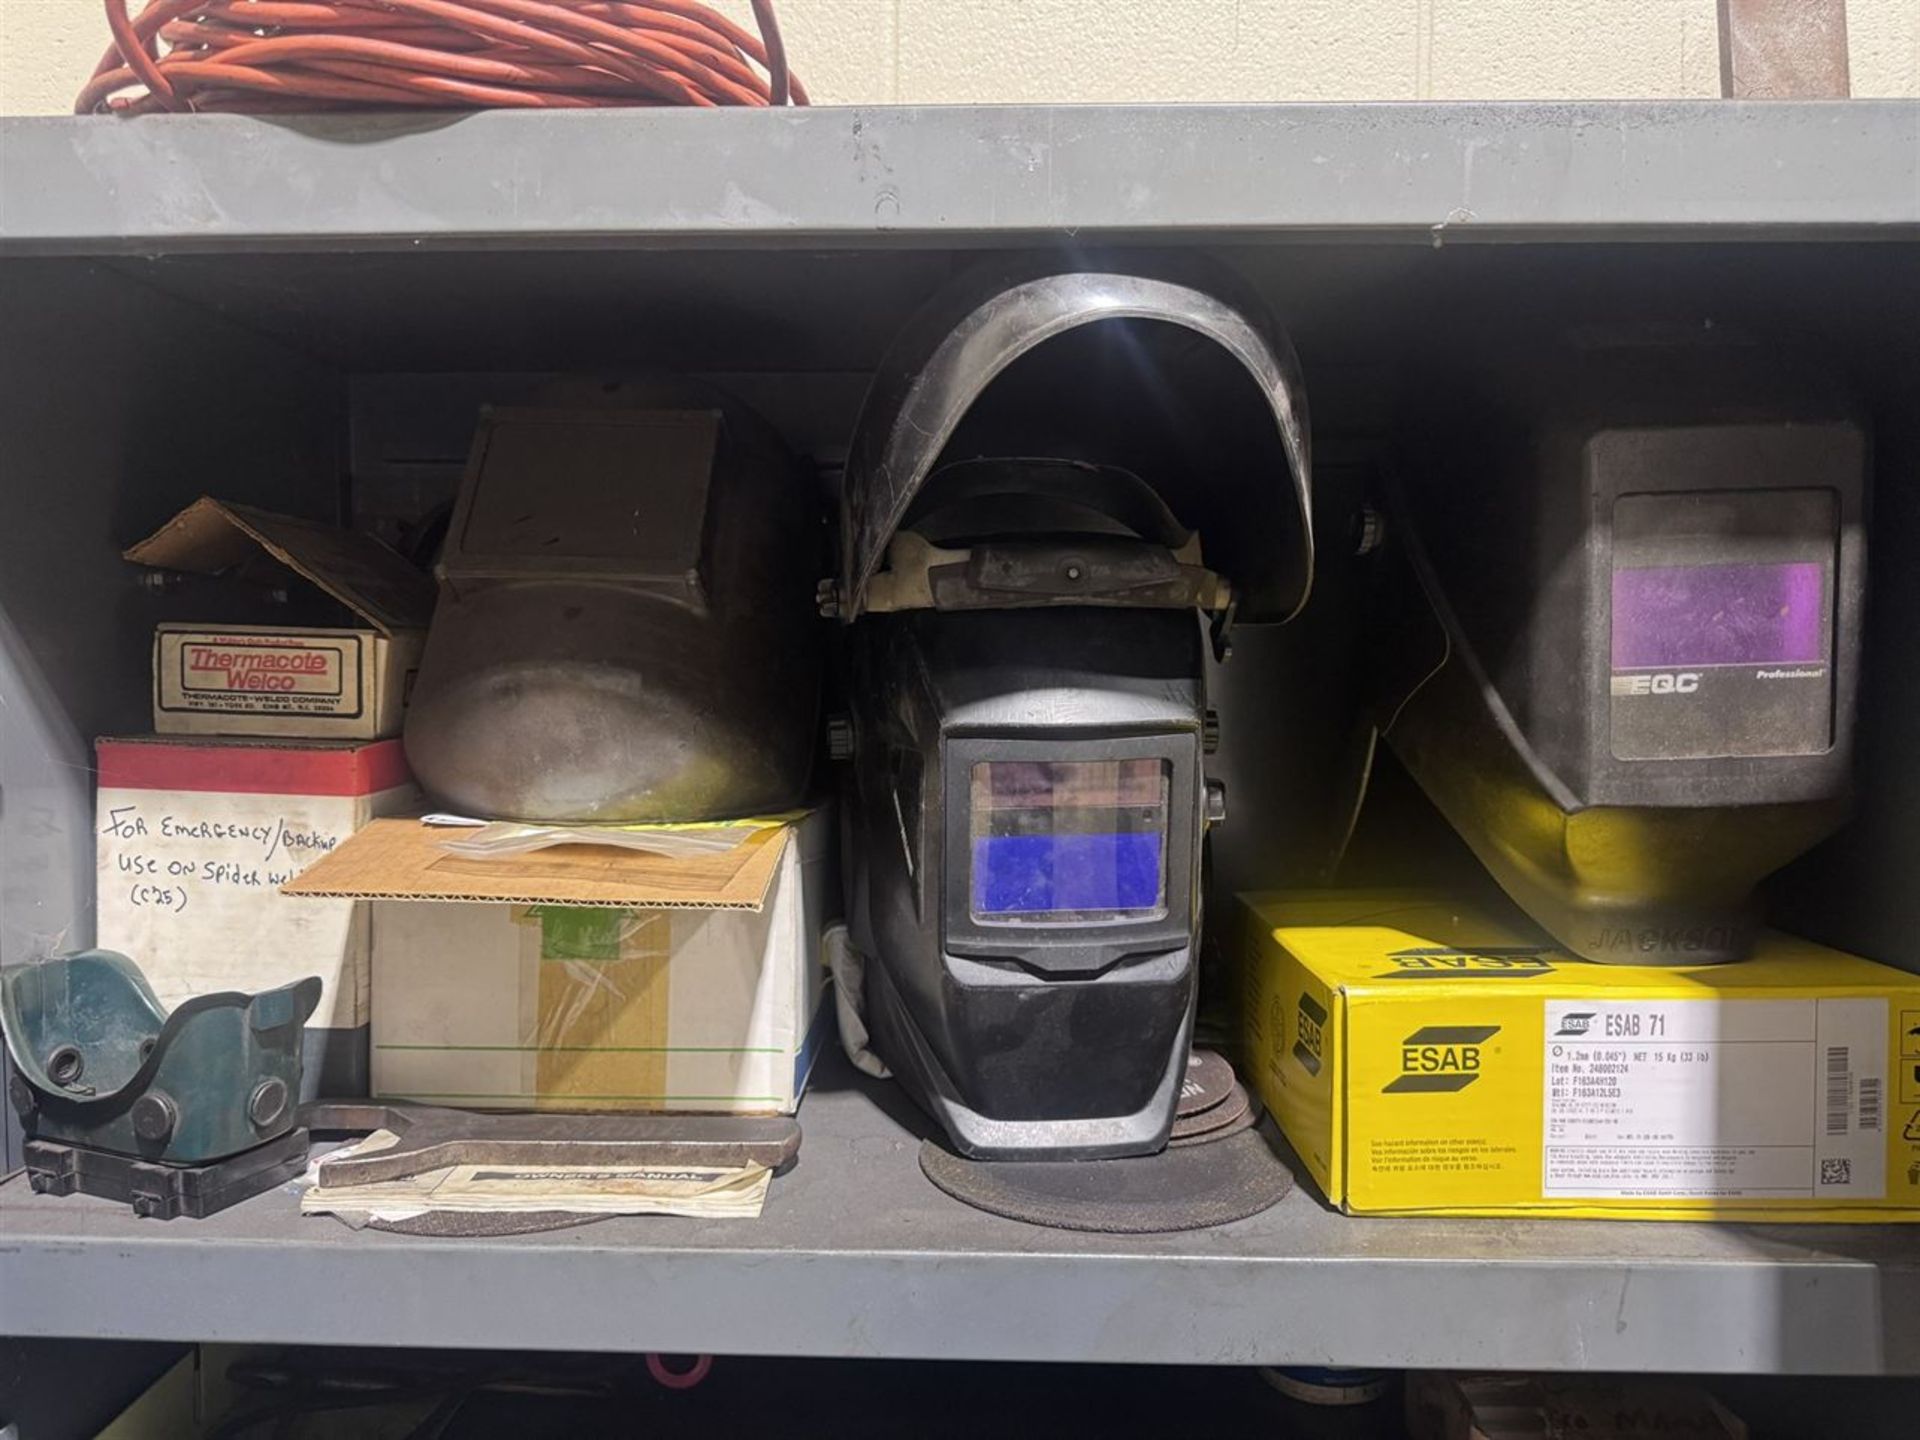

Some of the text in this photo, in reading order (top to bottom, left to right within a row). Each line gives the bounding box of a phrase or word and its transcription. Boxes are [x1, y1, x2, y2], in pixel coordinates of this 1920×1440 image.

[191, 648, 327, 669] Thermacote
[227, 669, 296, 691] Welco
[1756, 669, 1824, 680] Professional
[1611, 673, 1698, 695] EQC
[167, 860, 196, 876] ON
[130, 884, 188, 913] (C25)
[1297, 1006, 1322, 1058] ESAB
[1560, 1019, 1590, 1030] ESAB
[1605, 1014, 1665, 1036] ESAB 71
[1402, 1046, 1481, 1072] ESAB
[1633, 1052, 1648, 1061] NET
[1654, 1052, 1663, 1061] 15
[1667, 1052, 1676, 1063] Kg
[1551, 1064, 1569, 1074] Item
[1572, 1064, 1586, 1074] No.
[1551, 1076, 1569, 1086] Lot:
[514, 1172, 704, 1181] OWNER'S MANUAL
